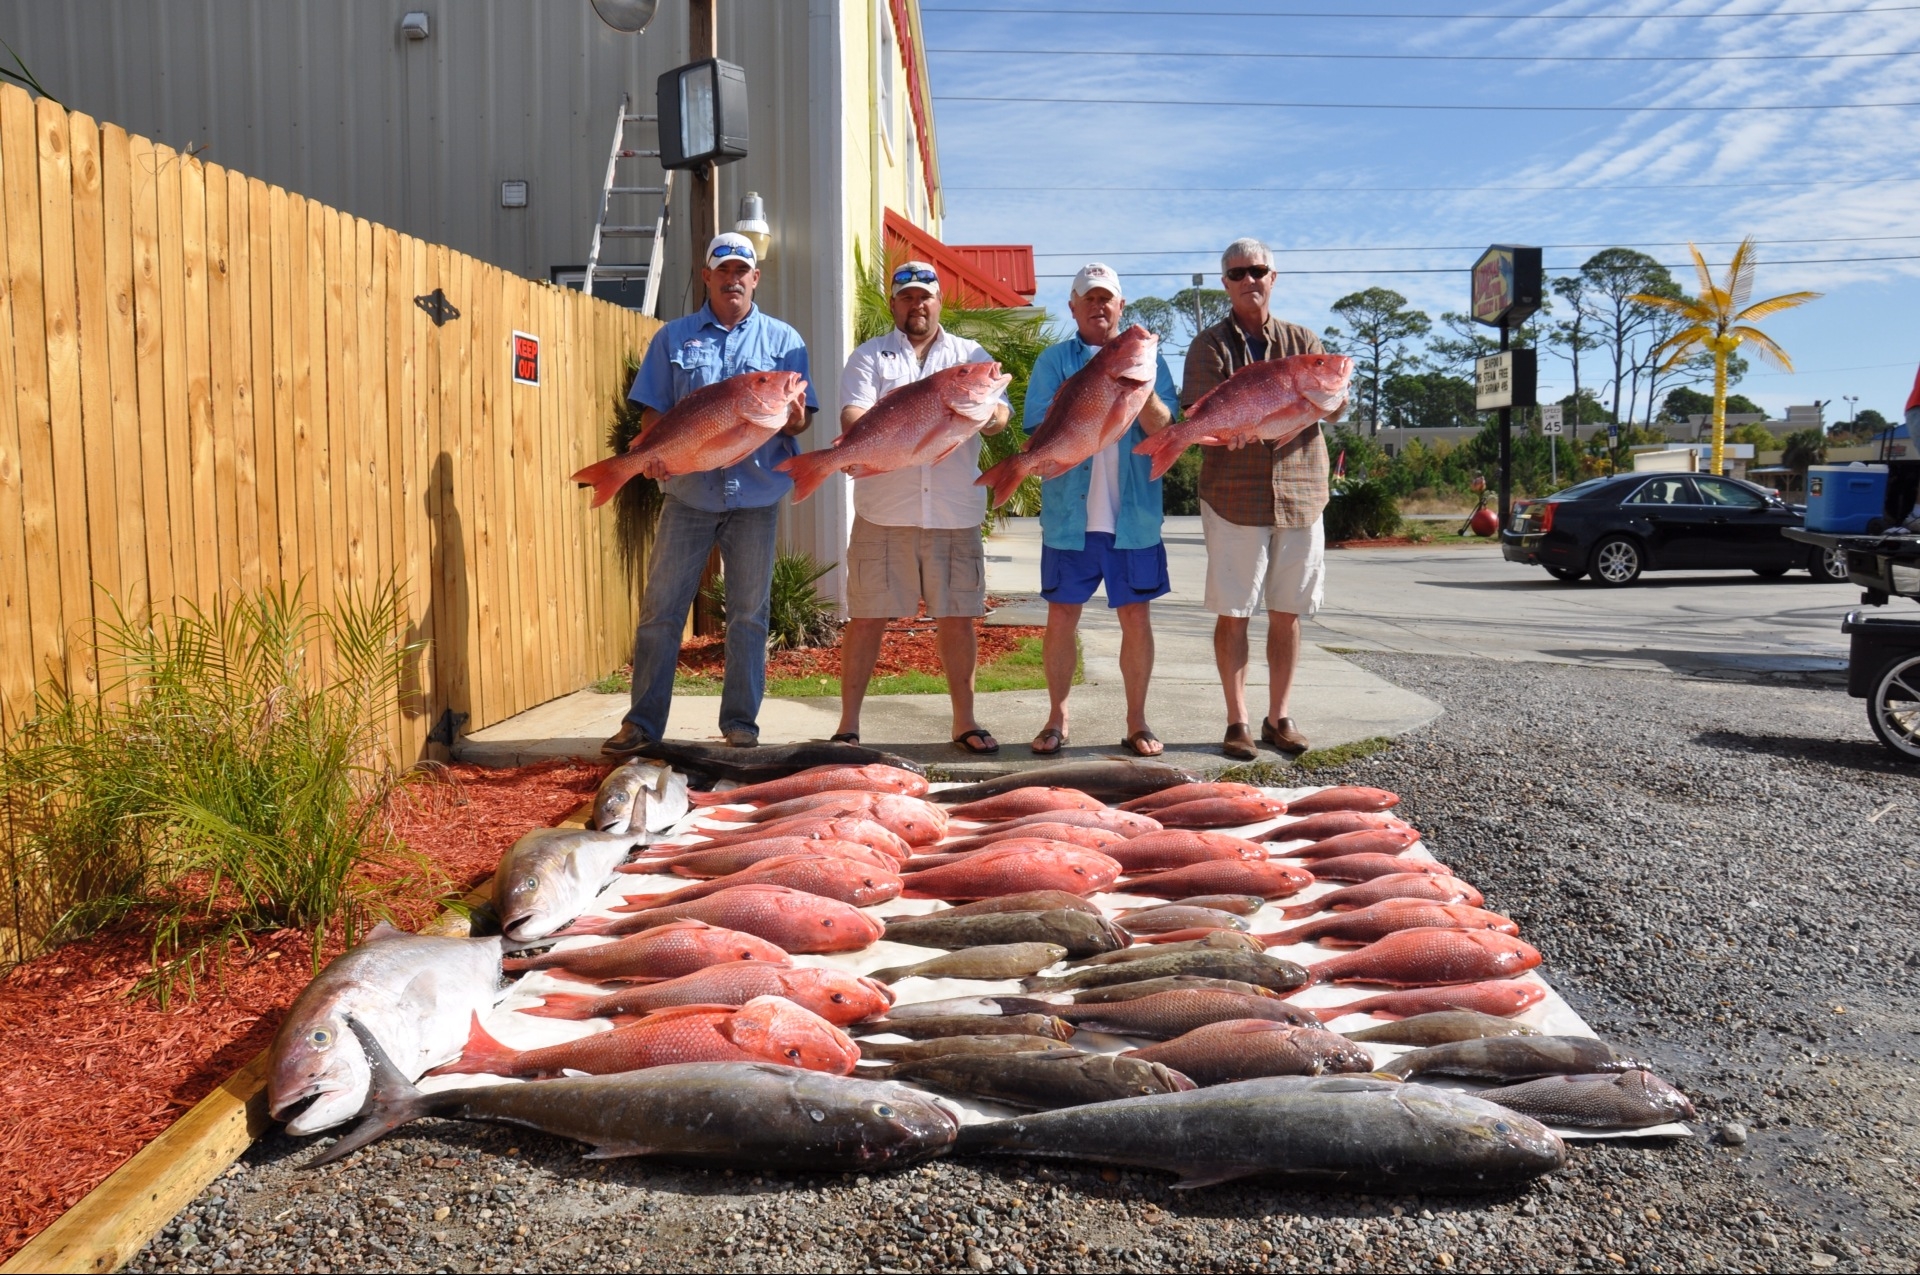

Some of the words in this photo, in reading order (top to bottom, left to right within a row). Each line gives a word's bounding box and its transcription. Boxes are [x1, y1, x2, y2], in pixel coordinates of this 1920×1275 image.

[515, 336, 538, 360] KEEP
[518, 359, 536, 380] OUT
[1498, 367, 1508, 379] FREE
[1544, 421, 1562, 432] 45
